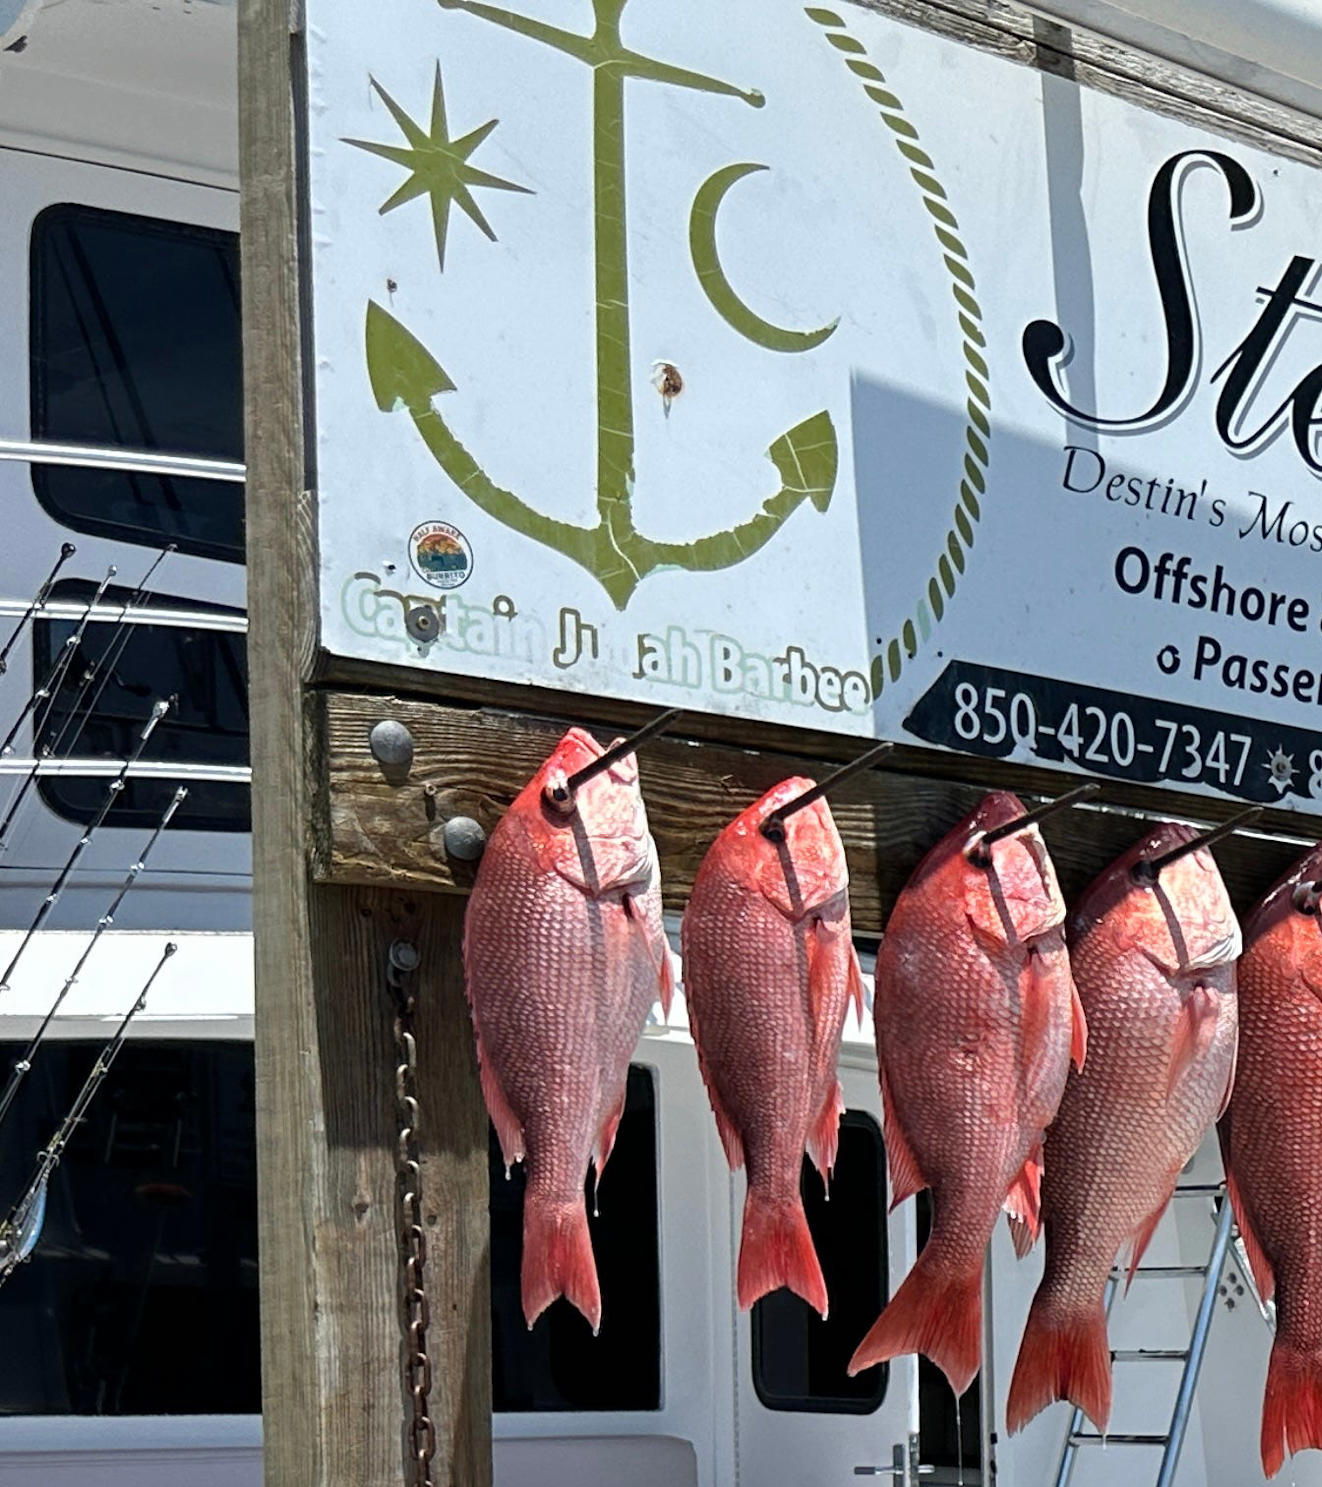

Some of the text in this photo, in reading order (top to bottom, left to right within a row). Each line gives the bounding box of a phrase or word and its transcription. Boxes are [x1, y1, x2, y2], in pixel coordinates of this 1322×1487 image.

[1062, 445, 1227, 527] Destin's
[1115, 546, 1311, 632] Offshore
[710, 632, 872, 713] Barbee
[954, 682, 1253, 787] 850-420-7347
